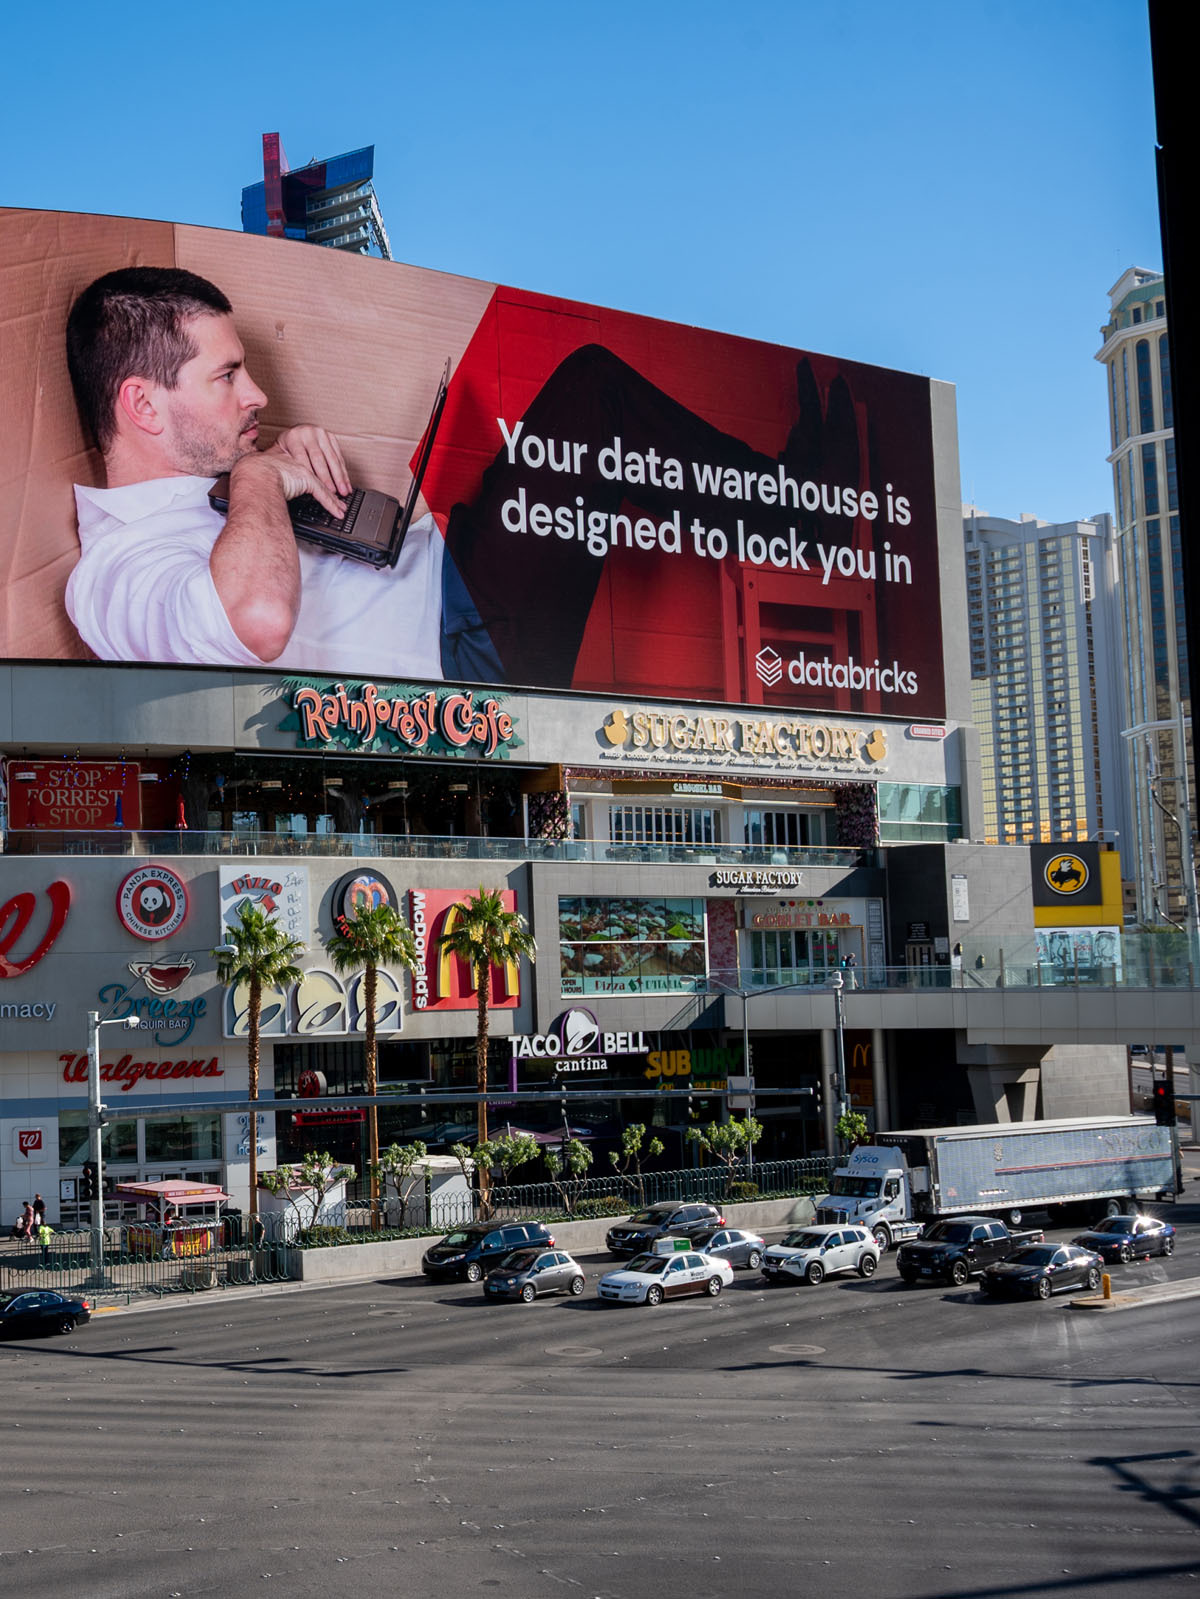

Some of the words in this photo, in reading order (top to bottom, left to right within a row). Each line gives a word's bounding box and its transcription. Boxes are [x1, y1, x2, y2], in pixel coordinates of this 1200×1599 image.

[497, 417, 588, 475] Your
[599, 437, 684, 490] data
[692, 462, 879, 520] warehouse
[886, 483, 912, 526] is
[501, 488, 682, 556] designed
[690, 519, 728, 559] to
[737, 520, 810, 571] lock
[817, 543, 876, 585] you
[885, 541, 912, 584] in
[788, 652, 918, 695] databricks
[294, 684, 437, 748] Rainforest
[442, 690, 514, 757] Cafe
[631, 711, 733, 751] SUGAR
[740, 719, 863, 759] FACTORY
[49, 769, 102, 788] STOP
[27, 789, 124, 807] FORREST
[50, 807, 102, 826] STOP
[123, 872, 149, 899] PANDA
[151, 870, 183, 900] EXPRESS
[716, 870, 753, 884] SUGAR
[756, 871, 803, 885] FACTORY
[126, 912, 152, 935] CHINESE
[155, 913, 181, 935] KITCHEN
[754, 912, 814, 926] GOBLET
[818, 913, 852, 926] BAR
[411, 891, 428, 1010] McDonald's
[562, 978, 576, 986] OPEN
[595, 980, 625, 991] Pizza
[99, 983, 207, 1047] Breeze
[169, 1020, 188, 1029] BAR
[508, 1035, 560, 1057] TACO
[604, 1032, 649, 1054] BELL
[59, 1054, 224, 1091] Walgreens
[555, 1057, 608, 1072] cantina
[644, 1046, 743, 1079] SUBWAY
[239, 1116, 264, 1127] opn
[237, 1144, 269, 1156] hors
